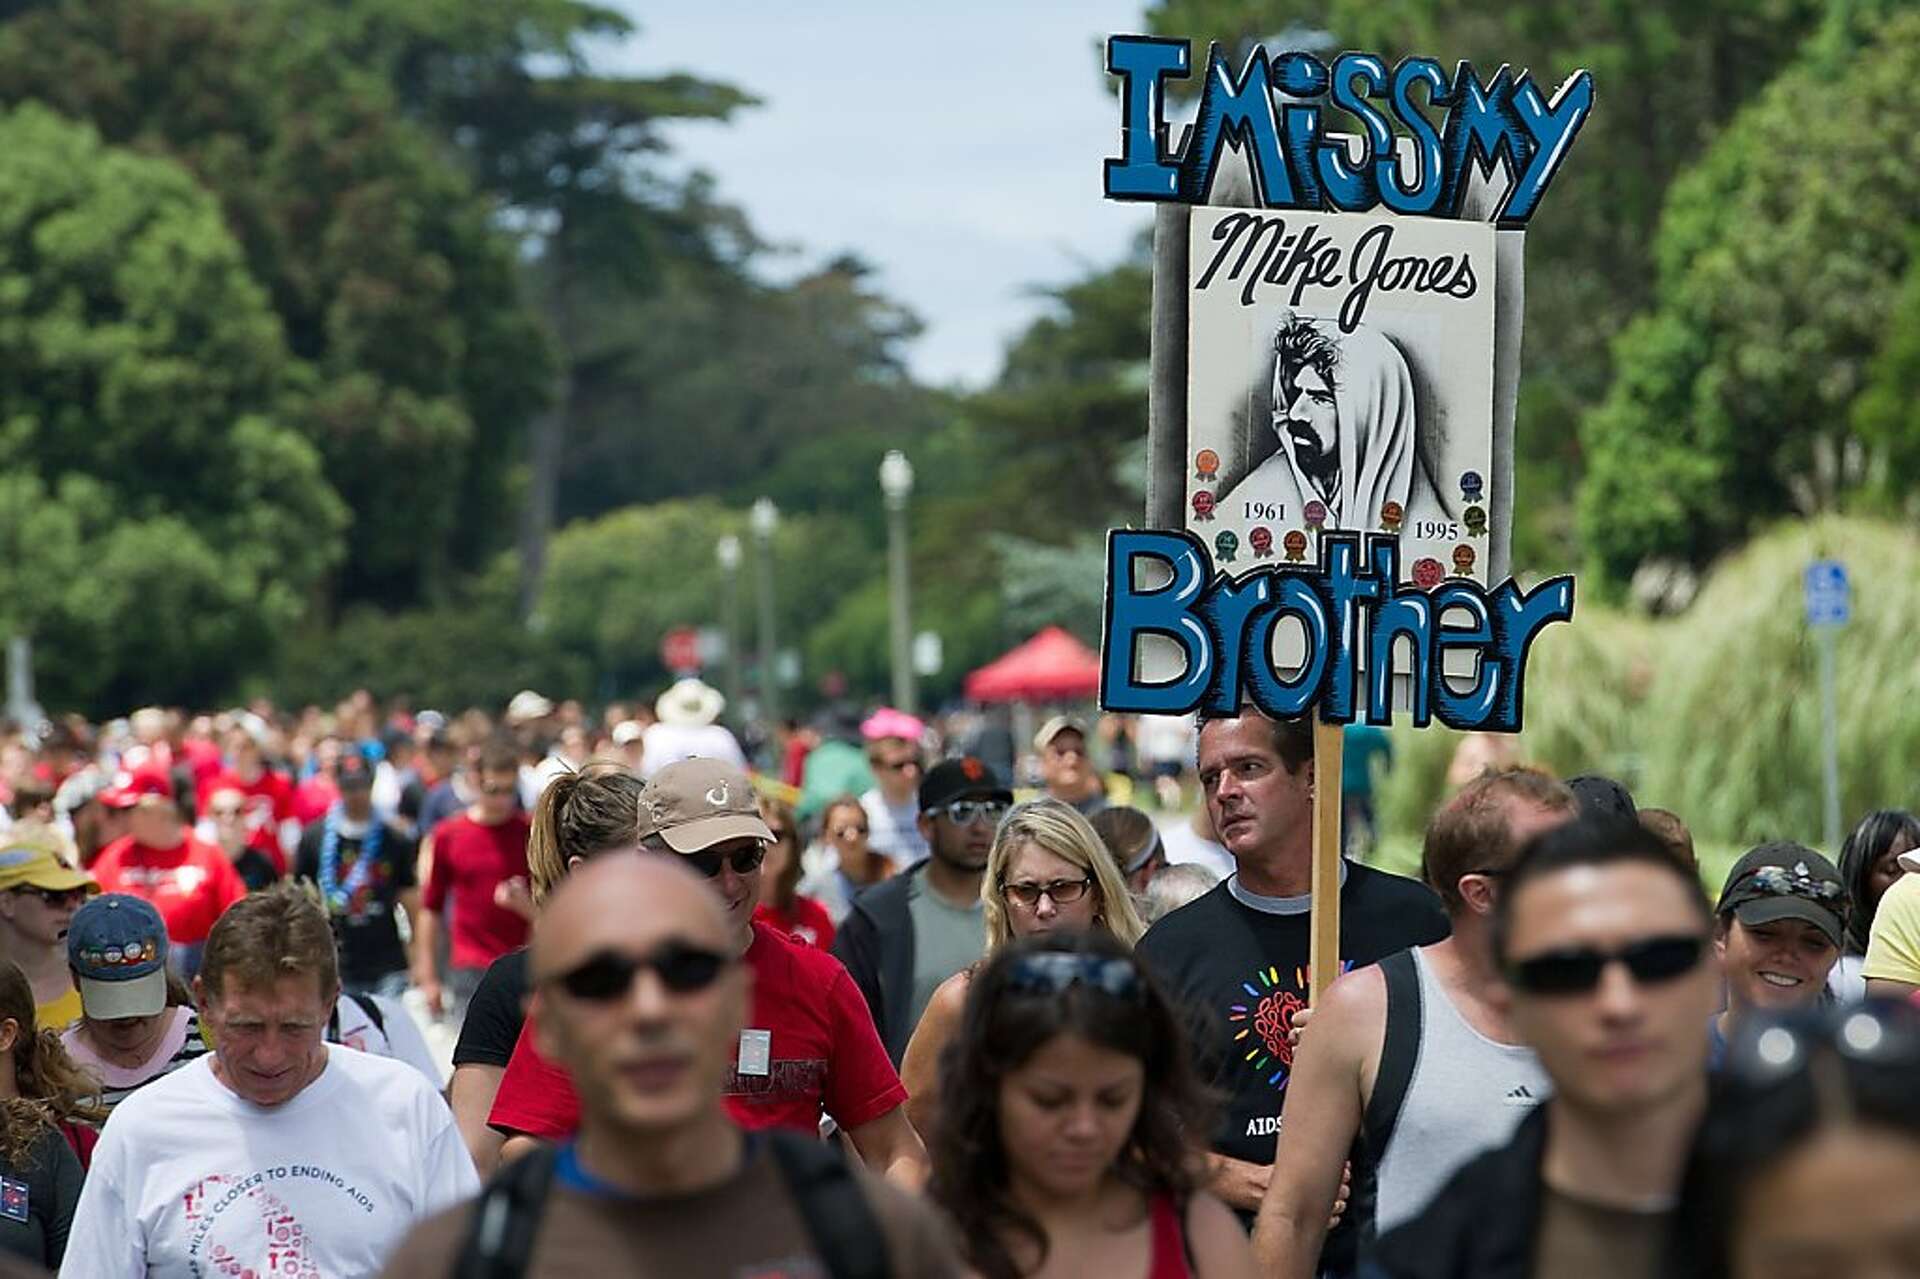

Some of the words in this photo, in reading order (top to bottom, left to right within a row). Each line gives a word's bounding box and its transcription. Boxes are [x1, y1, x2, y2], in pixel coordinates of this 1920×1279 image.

[1104, 34, 1191, 202] I
[1444, 59, 1594, 224] MY
[1196, 212, 1343, 307] Mike
[1337, 224, 1478, 334] Jones
[1243, 501, 1286, 522] 1961
[1415, 520, 1459, 541] 1995
[1100, 529, 1576, 733] Brother
[189, 1215, 215, 1256] MILES
[212, 1172, 264, 1214] CLOSER
[266, 1166, 287, 1181] TO
[290, 1165, 345, 1189] ENDING
[346, 1186, 376, 1214] AIDS
